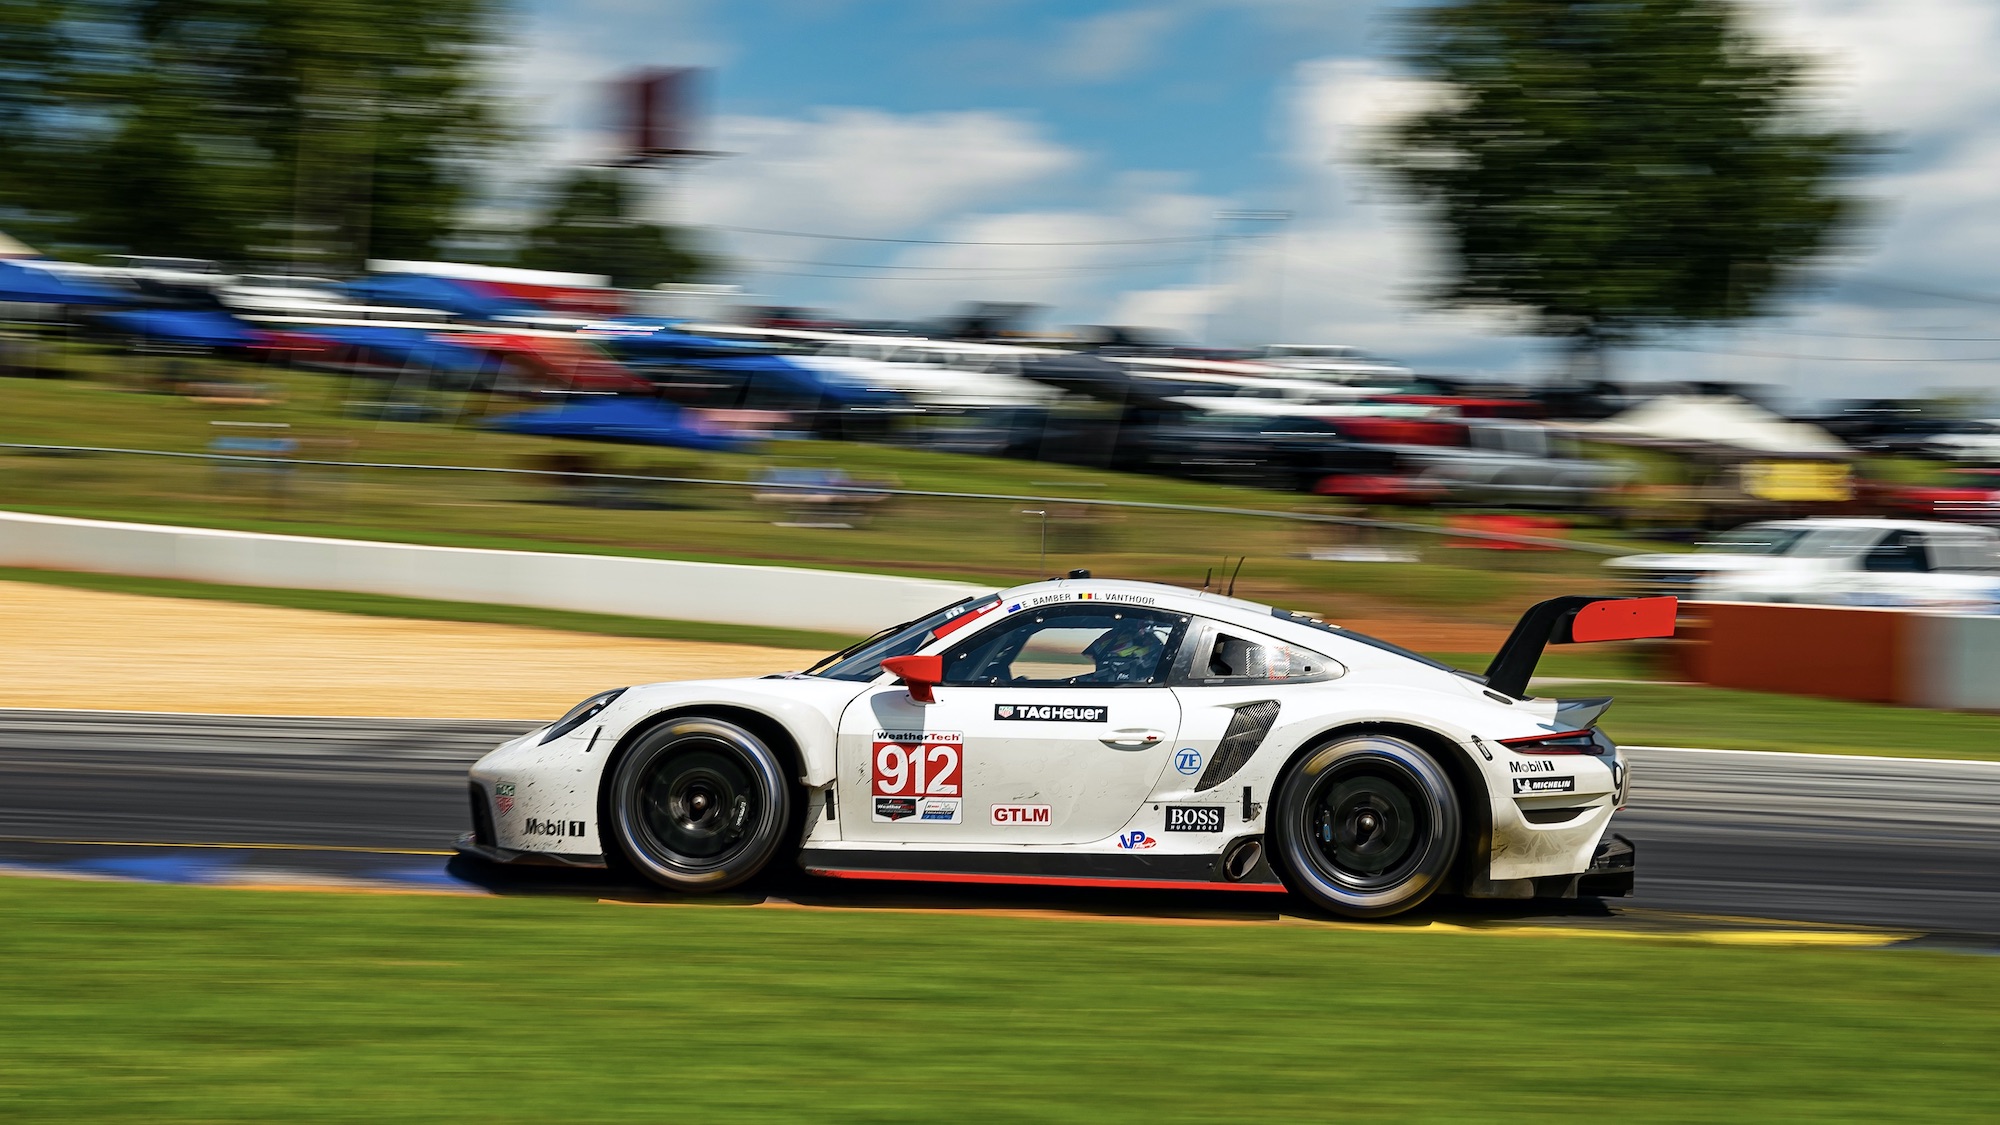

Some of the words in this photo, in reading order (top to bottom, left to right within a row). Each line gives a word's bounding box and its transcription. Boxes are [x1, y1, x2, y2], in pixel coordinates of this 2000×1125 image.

[1033, 593, 1071, 606] BAMBER
[1105, 593, 1155, 605] VANTHOOR
[877, 744, 959, 795] 912
[1509, 760, 1543, 773] Mobil
[1532, 780, 1571, 790] MICHELIN
[994, 808, 1049, 822] GTLM
[1170, 808, 1219, 825] BOSS
[522, 817, 565, 836] Mobil
[1120, 830, 1146, 850] VP
